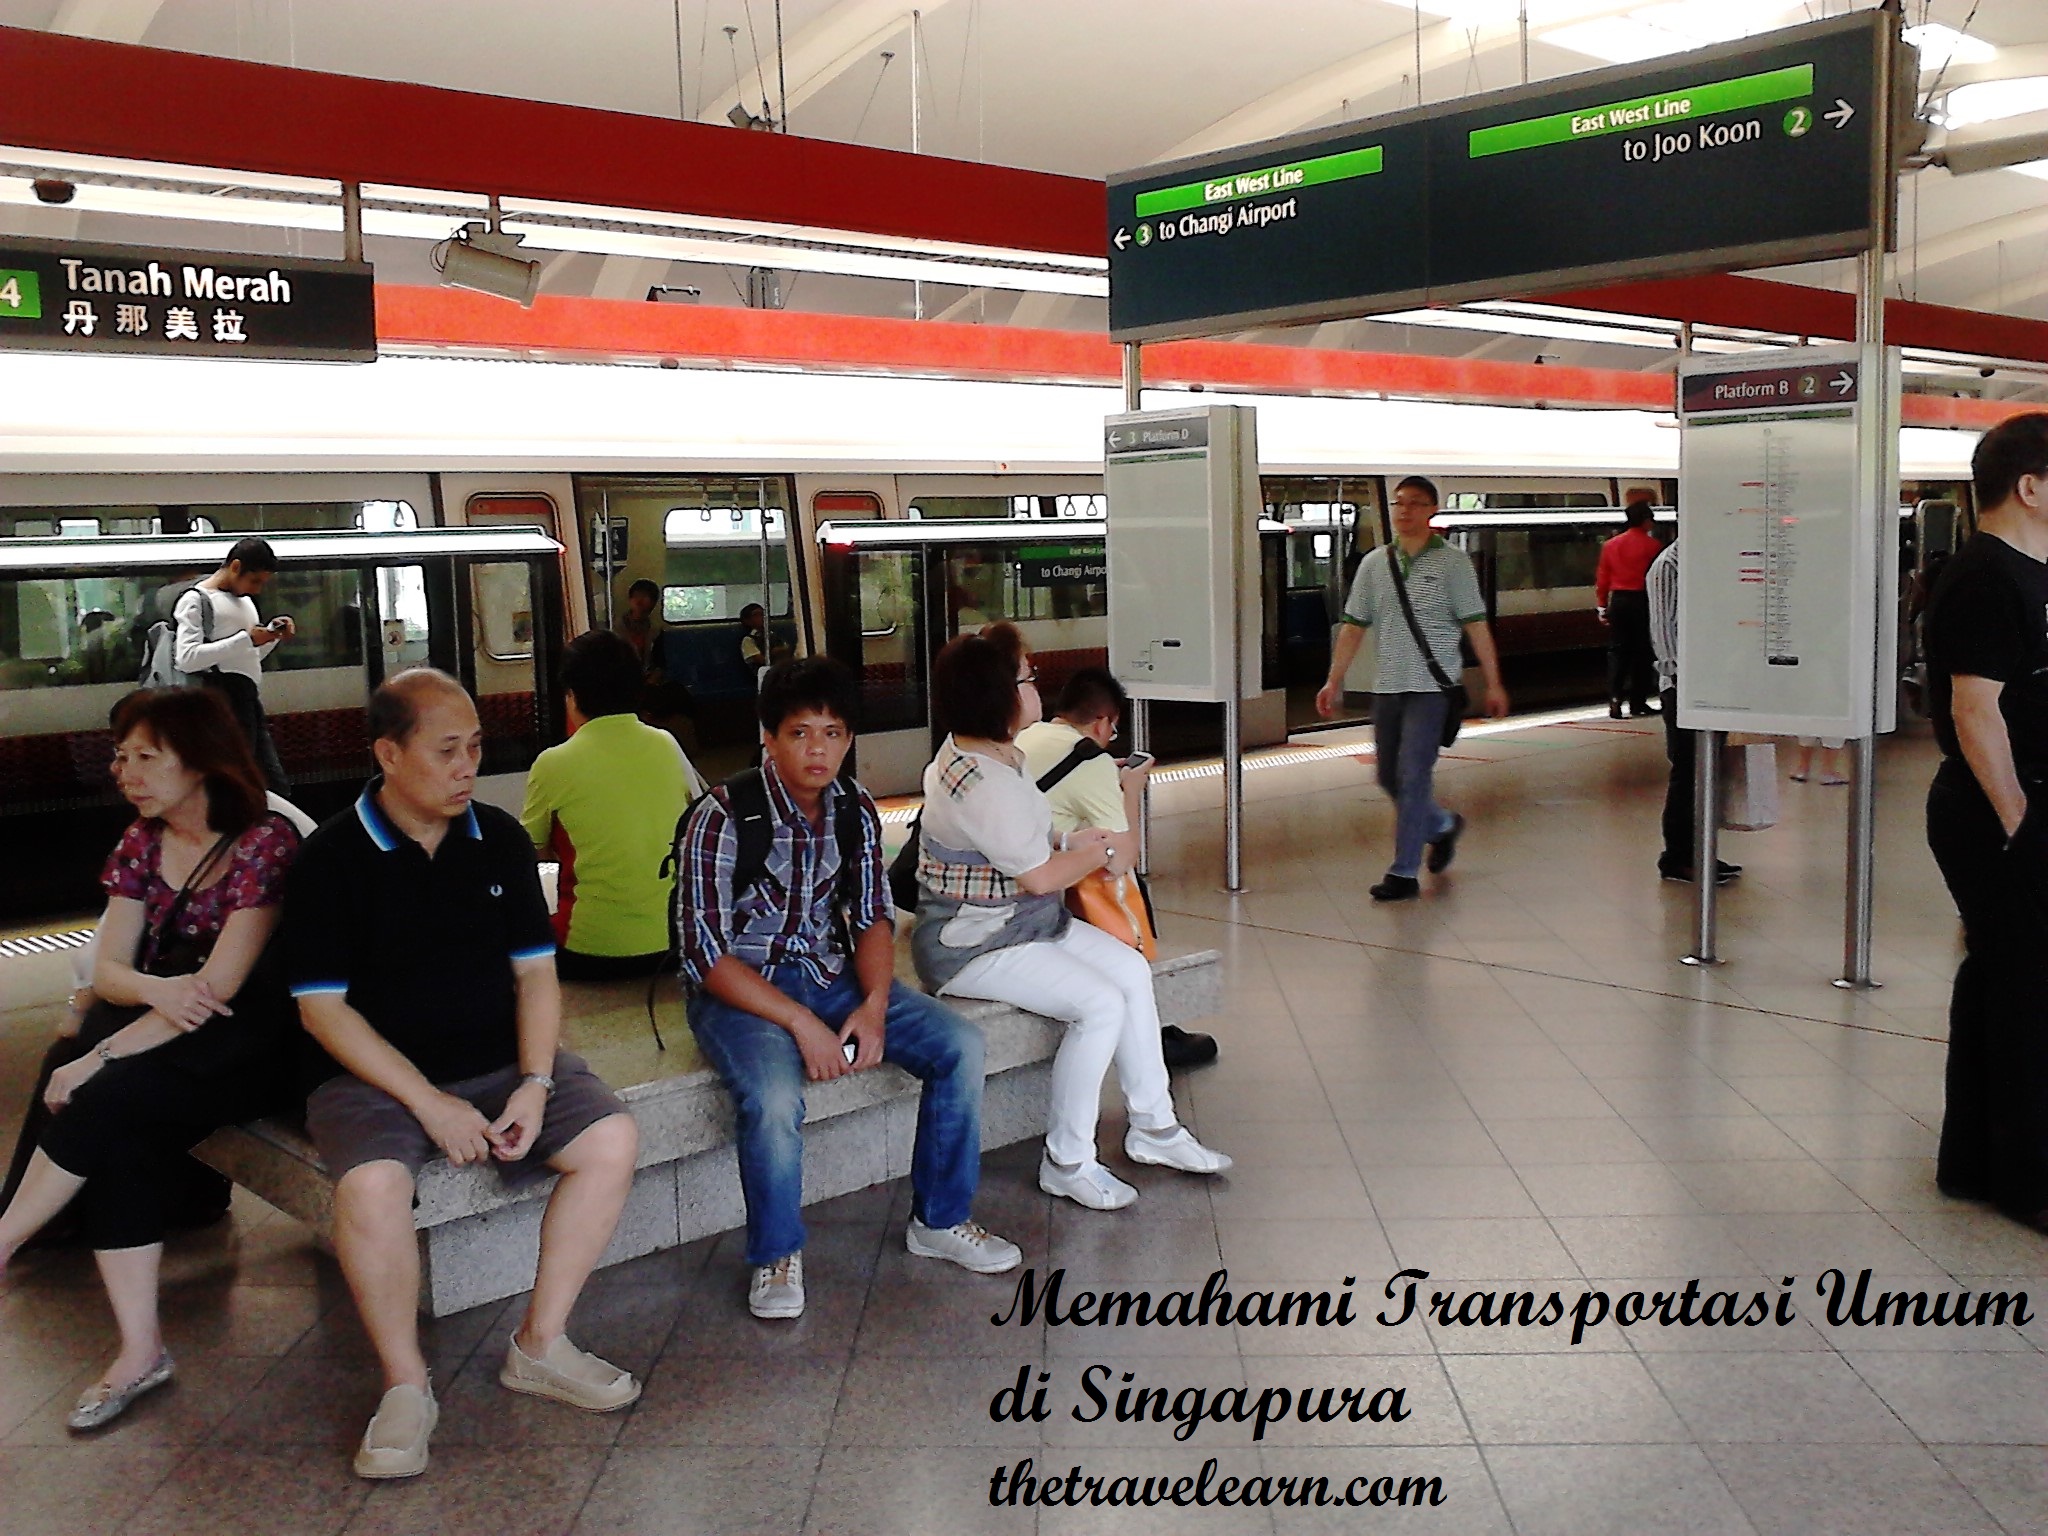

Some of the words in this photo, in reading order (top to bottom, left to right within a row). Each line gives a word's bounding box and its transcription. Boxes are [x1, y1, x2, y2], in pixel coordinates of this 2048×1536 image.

[1571, 114, 1605, 135] East
[1609, 104, 1650, 128] West
[1653, 97, 1692, 120] Line
[1623, 138, 1647, 162] to
[1651, 131, 1692, 163] Joo
[1699, 118, 1761, 149] Koon
[1788, 110, 1806, 136] 2
[1204, 183, 1233, 202] East
[1236, 173, 1271, 195] West
[1272, 167, 1304, 189] Line
[1158, 221, 1176, 241] to
[1179, 206, 1234, 236] Changi
[1236, 197, 1297, 228] Airport
[59, 258, 172, 297] Tanah
[182, 266, 291, 303] Merah
[63, 300, 248, 342] 丹那美拉
[1714, 381, 1775, 400] Platform
[1778, 379, 1790, 396] B
[1803, 376, 1816, 394] 2
[1181, 428, 1189, 440] D
[1041, 567, 1051, 578] to
[1052, 563, 1082, 579] Changi
[1083, 563, 1107, 578] Airpo
